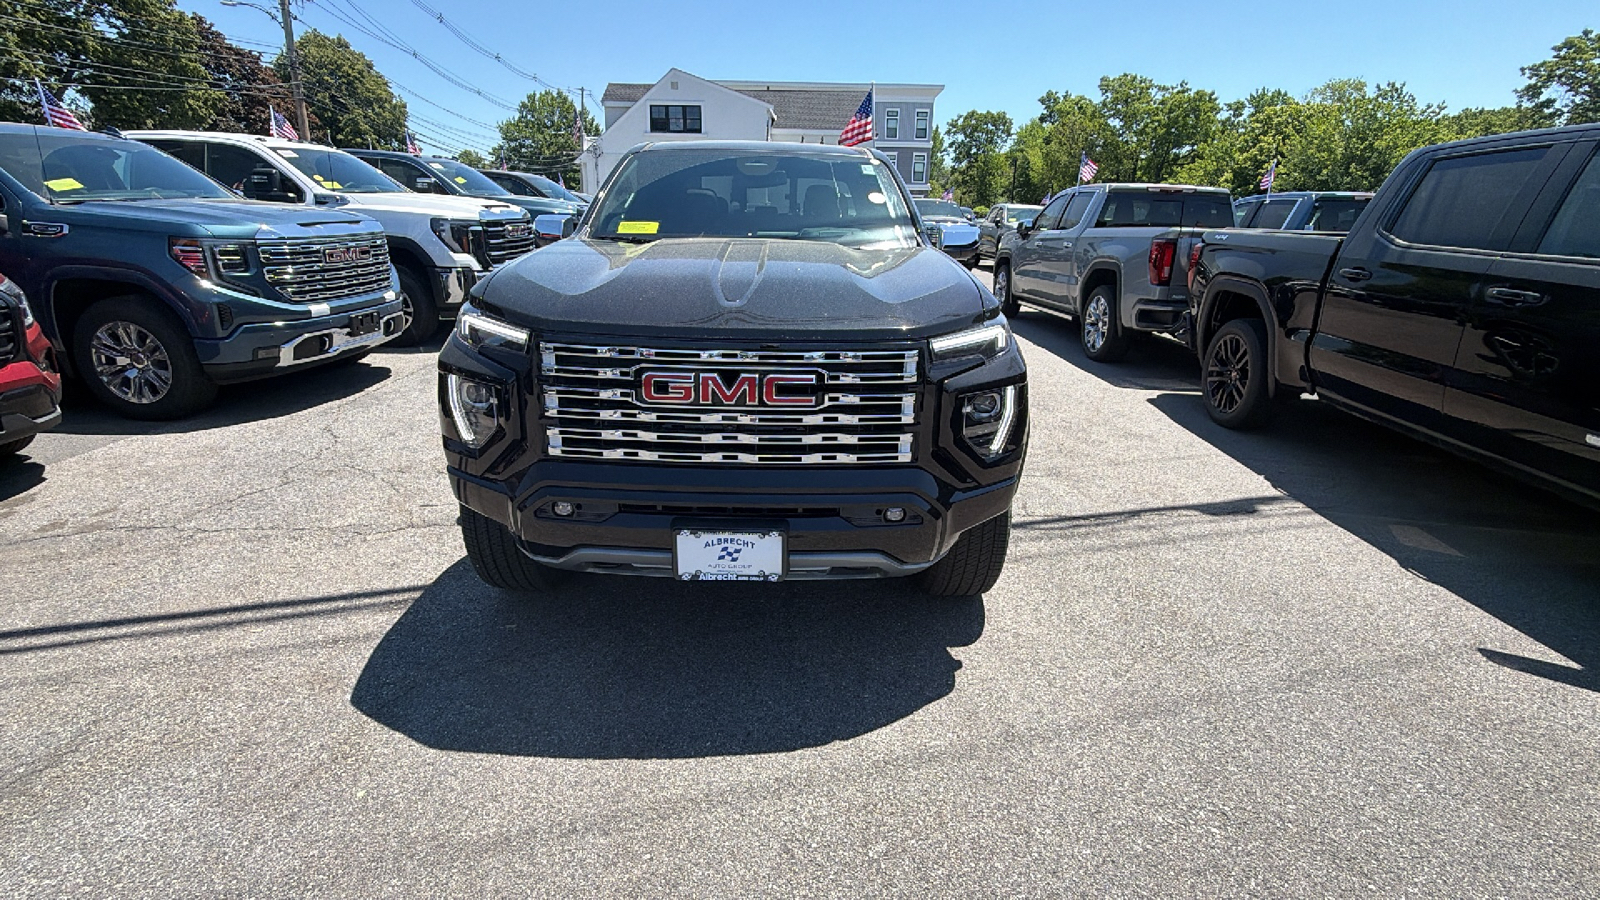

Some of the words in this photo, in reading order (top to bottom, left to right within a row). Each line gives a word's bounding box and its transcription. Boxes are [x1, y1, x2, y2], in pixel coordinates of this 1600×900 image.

[326, 246, 370, 262] GMC
[642, 371, 816, 406] GMC
[703, 537, 756, 549] ALBRECHT
[699, 572, 738, 581] Albrecht
